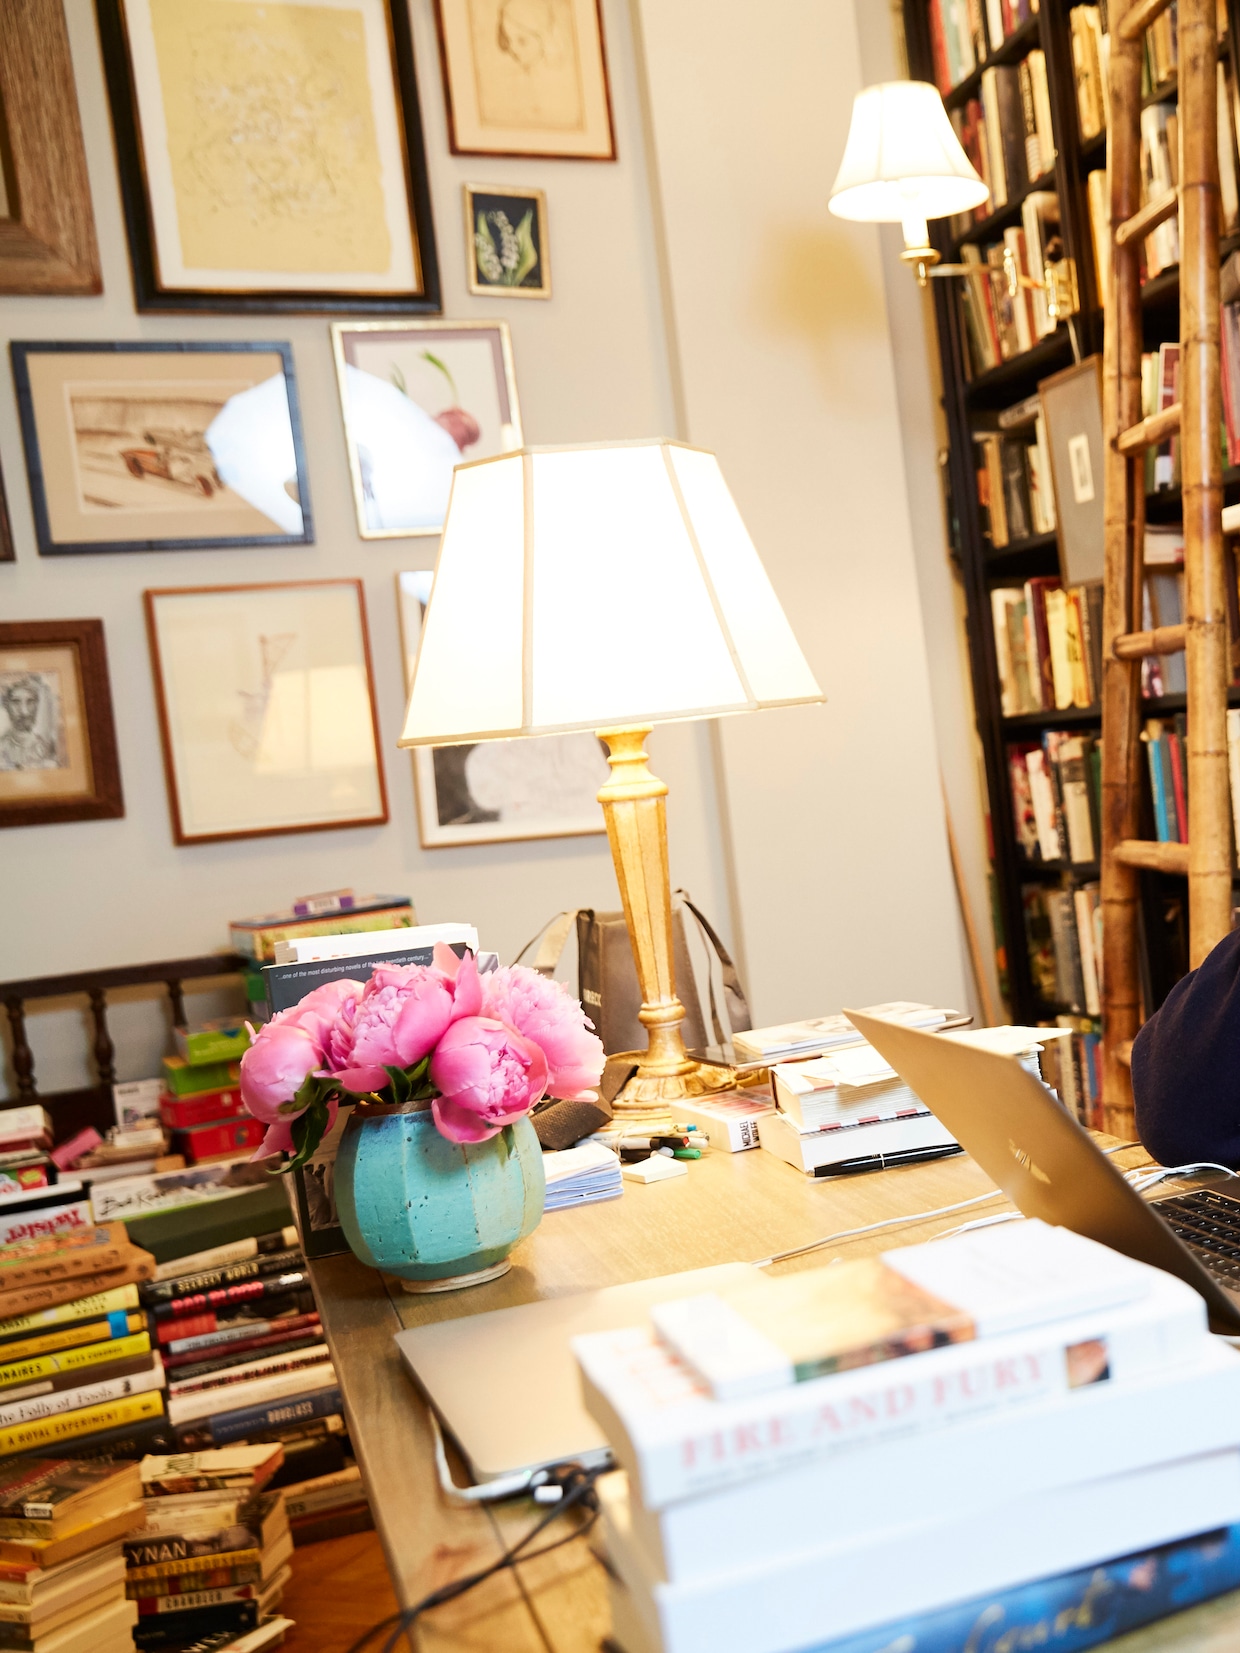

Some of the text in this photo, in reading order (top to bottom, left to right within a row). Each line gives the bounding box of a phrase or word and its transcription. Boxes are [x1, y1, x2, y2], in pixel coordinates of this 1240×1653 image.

[307, 969, 320, 977] most
[320, 964, 345, 975] disturbing
[345, 962, 361, 971] novels
[739, 1120, 751, 1148] MICHAEL
[5, 1207, 86, 1246] Twister
[55, 1410, 119, 1435] EXPERIMENT
[681, 1413, 797, 1469] FIRE
[810, 1384, 918, 1440] AND
[931, 1350, 1048, 1407] FURY
